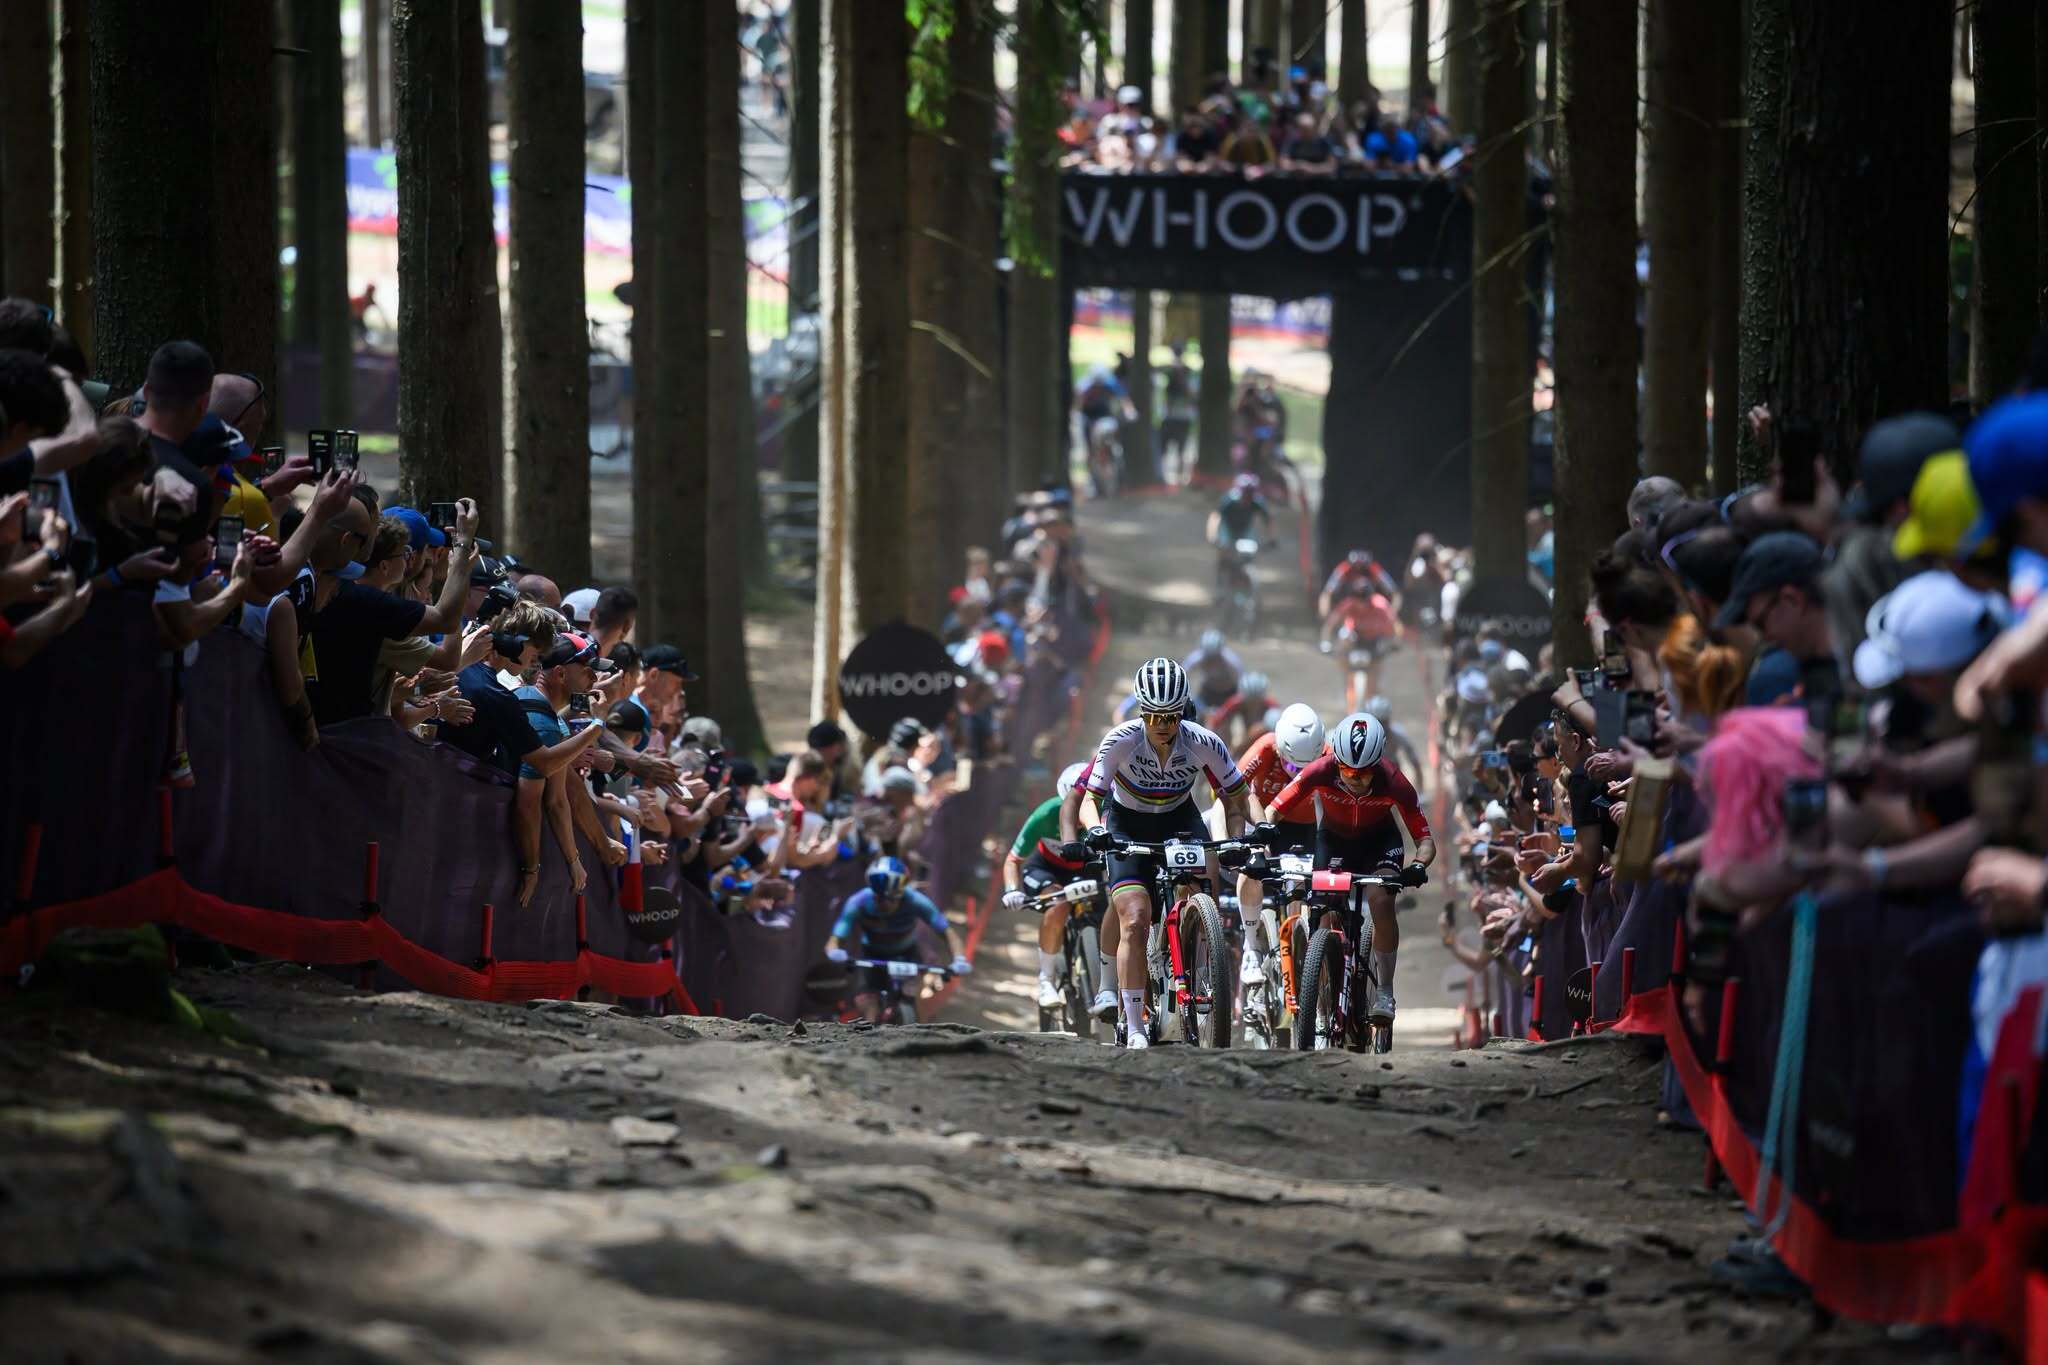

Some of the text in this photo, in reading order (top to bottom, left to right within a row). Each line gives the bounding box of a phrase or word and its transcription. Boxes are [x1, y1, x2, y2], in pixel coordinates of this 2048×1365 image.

[1065, 187, 1408, 254] WHOOP
[841, 672, 953, 697] WHOOP
[1128, 764, 1200, 781] CANYON
[1174, 851, 1198, 865] 69
[627, 908, 680, 924] WHOOP
